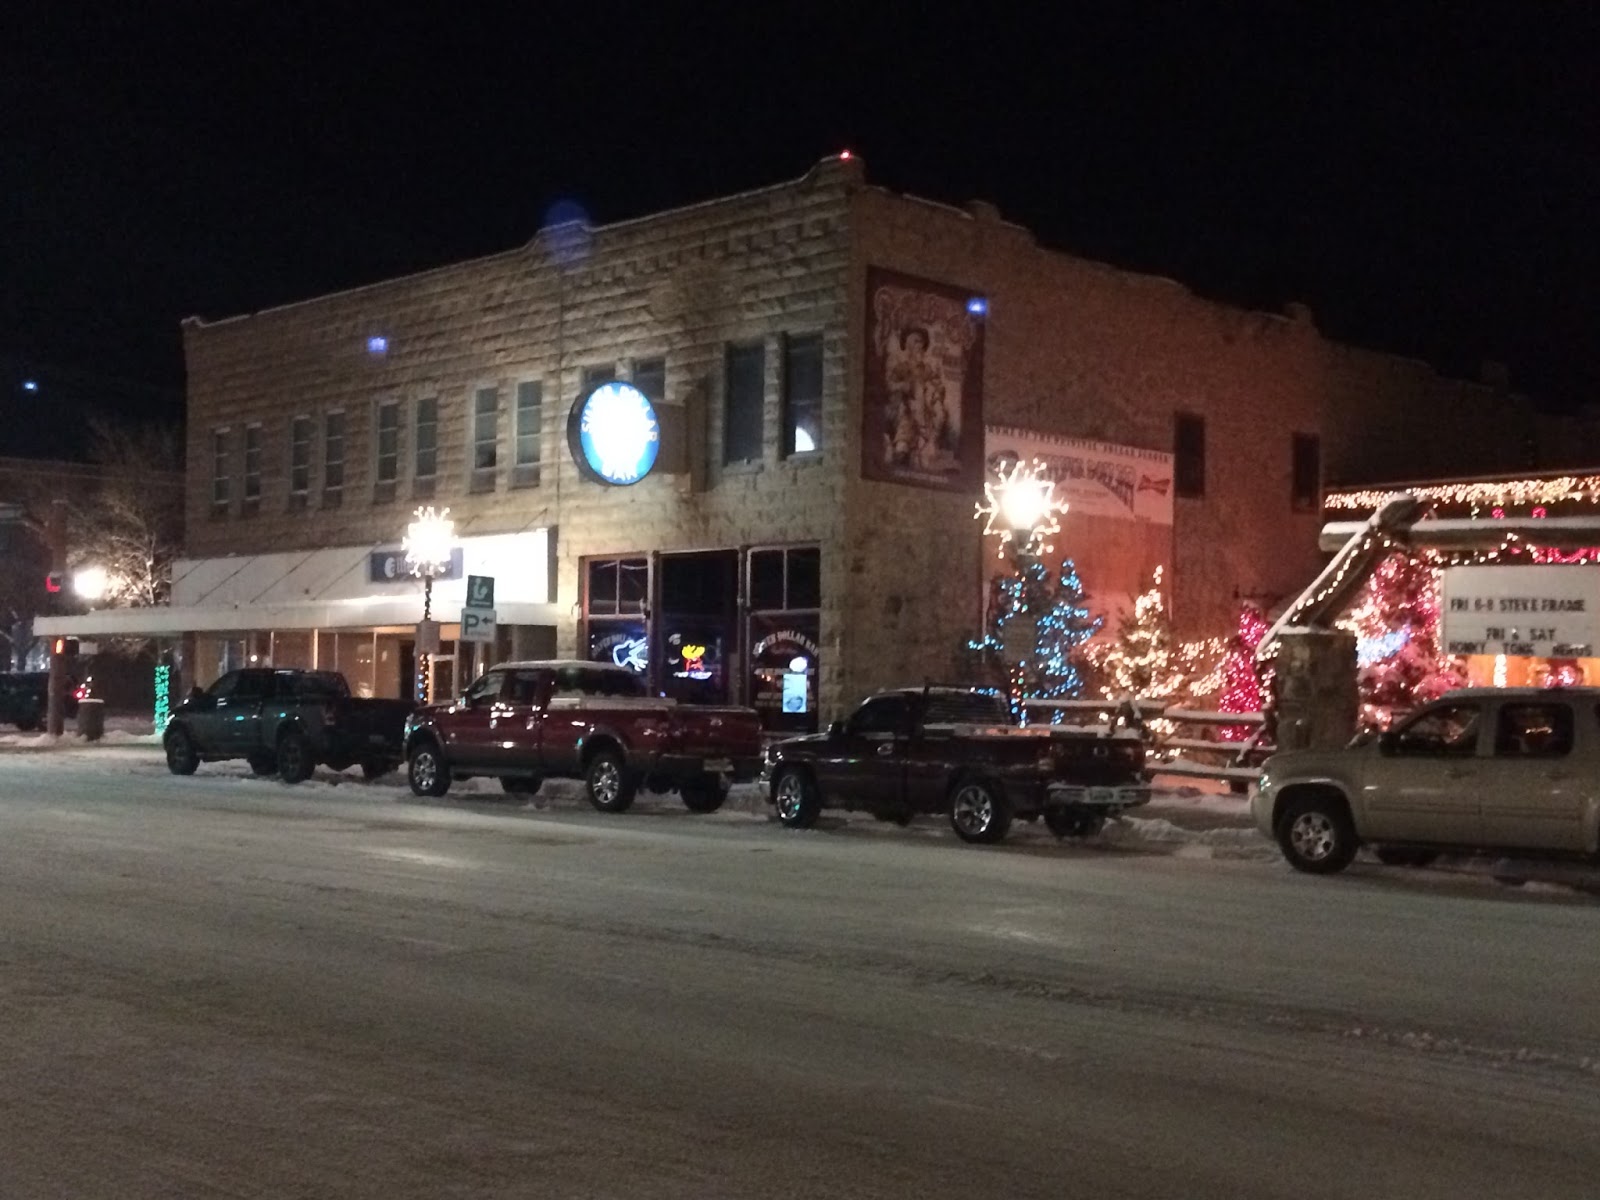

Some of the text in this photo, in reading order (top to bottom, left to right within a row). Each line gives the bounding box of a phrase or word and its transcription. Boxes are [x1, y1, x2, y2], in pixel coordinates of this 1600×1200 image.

[1450, 598, 1469, 612] FRI
[1499, 598, 1538, 612] STEVE
[1541, 598, 1585, 612] FRAME
[464, 614, 480, 636] P
[777, 629, 806, 646] DOLLAR
[1486, 627, 1505, 641] FRI
[1529, 628, 1556, 641] SAT
